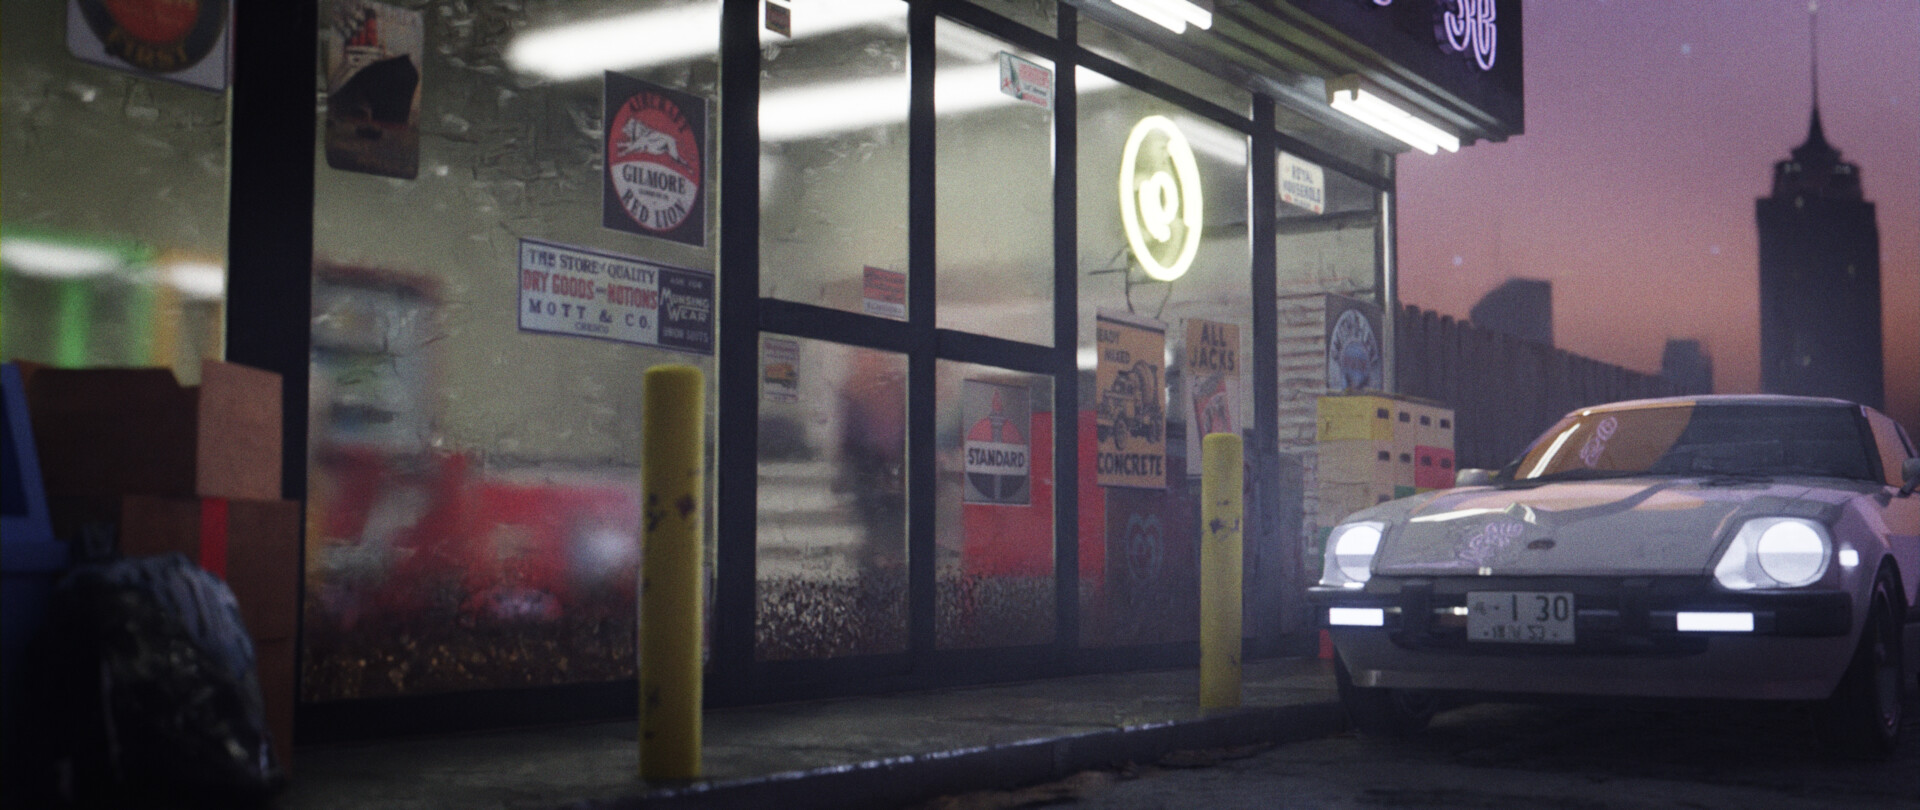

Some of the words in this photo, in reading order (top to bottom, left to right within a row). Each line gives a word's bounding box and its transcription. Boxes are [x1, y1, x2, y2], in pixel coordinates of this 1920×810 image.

[622, 164, 687, 195] GILMORE
[621, 188, 649, 223] RED
[655, 198, 687, 229] LION
[529, 249, 556, 266] THE
[560, 254, 599, 274] STORE
[608, 263, 656, 284] QUALITY
[523, 269, 548, 292] DRY
[552, 275, 594, 300] GOODS
[607, 283, 657, 310] NOTIONS
[529, 299, 586, 320] MOTT
[599, 309, 613, 323] &
[1201, 323, 1227, 348] ALL
[1189, 347, 1235, 373] JACKS
[967, 446, 1026, 470] STANDARD
[1097, 453, 1162, 477] CONCRETE
